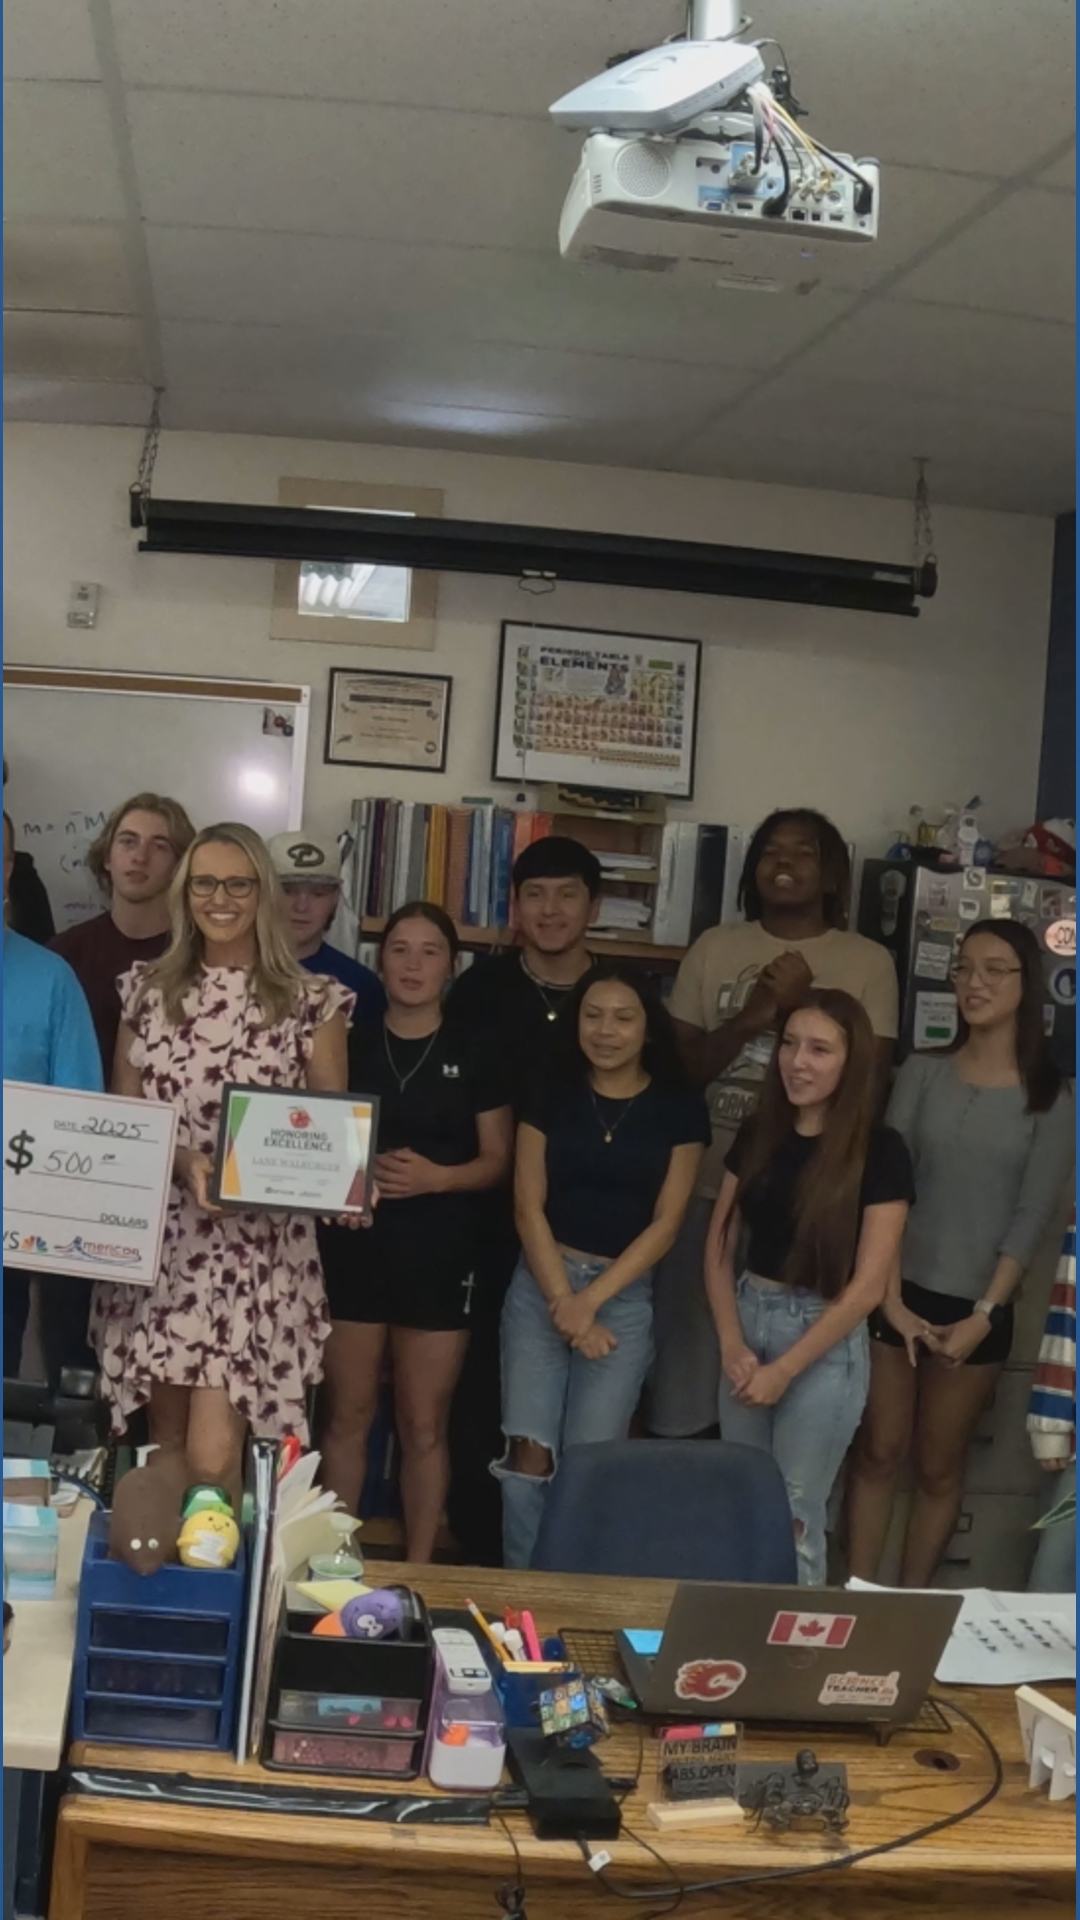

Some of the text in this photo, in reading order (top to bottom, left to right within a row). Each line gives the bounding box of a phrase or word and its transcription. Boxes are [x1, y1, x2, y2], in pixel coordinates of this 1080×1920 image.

[540, 656, 629, 673] ELEMENTS
[54, 1117, 149, 1139] DATE 2025
[270, 1129, 328, 1141] HONORING
[5, 1129, 35, 1175] $
[44, 1150, 92, 1175] 500
[264, 1137, 332, 1152] EXCELLENCE
[100, 1212, 148, 1229] DOLLARS
[828, 1675, 886, 1686] SCIENCE
[827, 1685, 879, 1694] TEACHER
[664, 1739, 737, 1755] MY BRAIN
